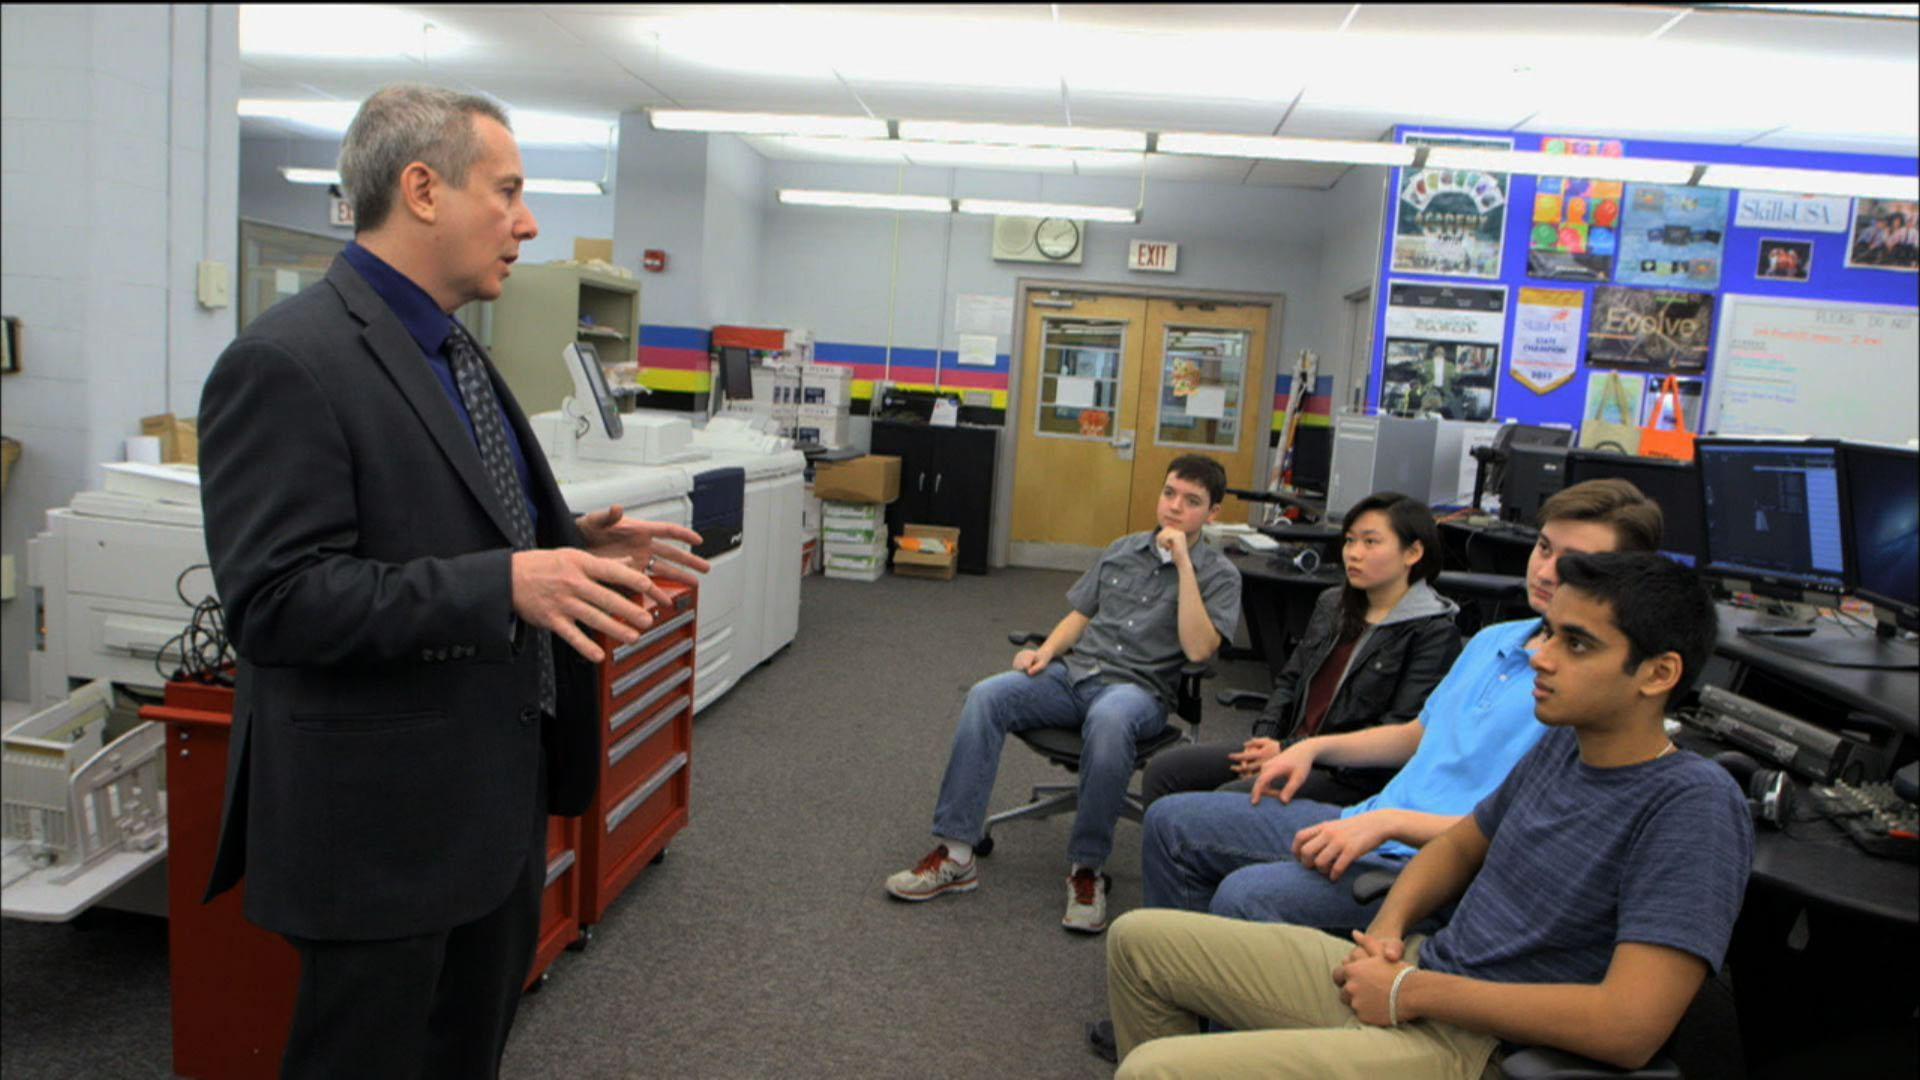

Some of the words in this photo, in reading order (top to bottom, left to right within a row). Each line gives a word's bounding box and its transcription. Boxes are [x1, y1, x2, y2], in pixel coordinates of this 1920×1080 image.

[1741, 197, 1834, 225] SkillsUSA
[1138, 244, 1168, 267] EXIT
[1602, 307, 1698, 338] Evolve
